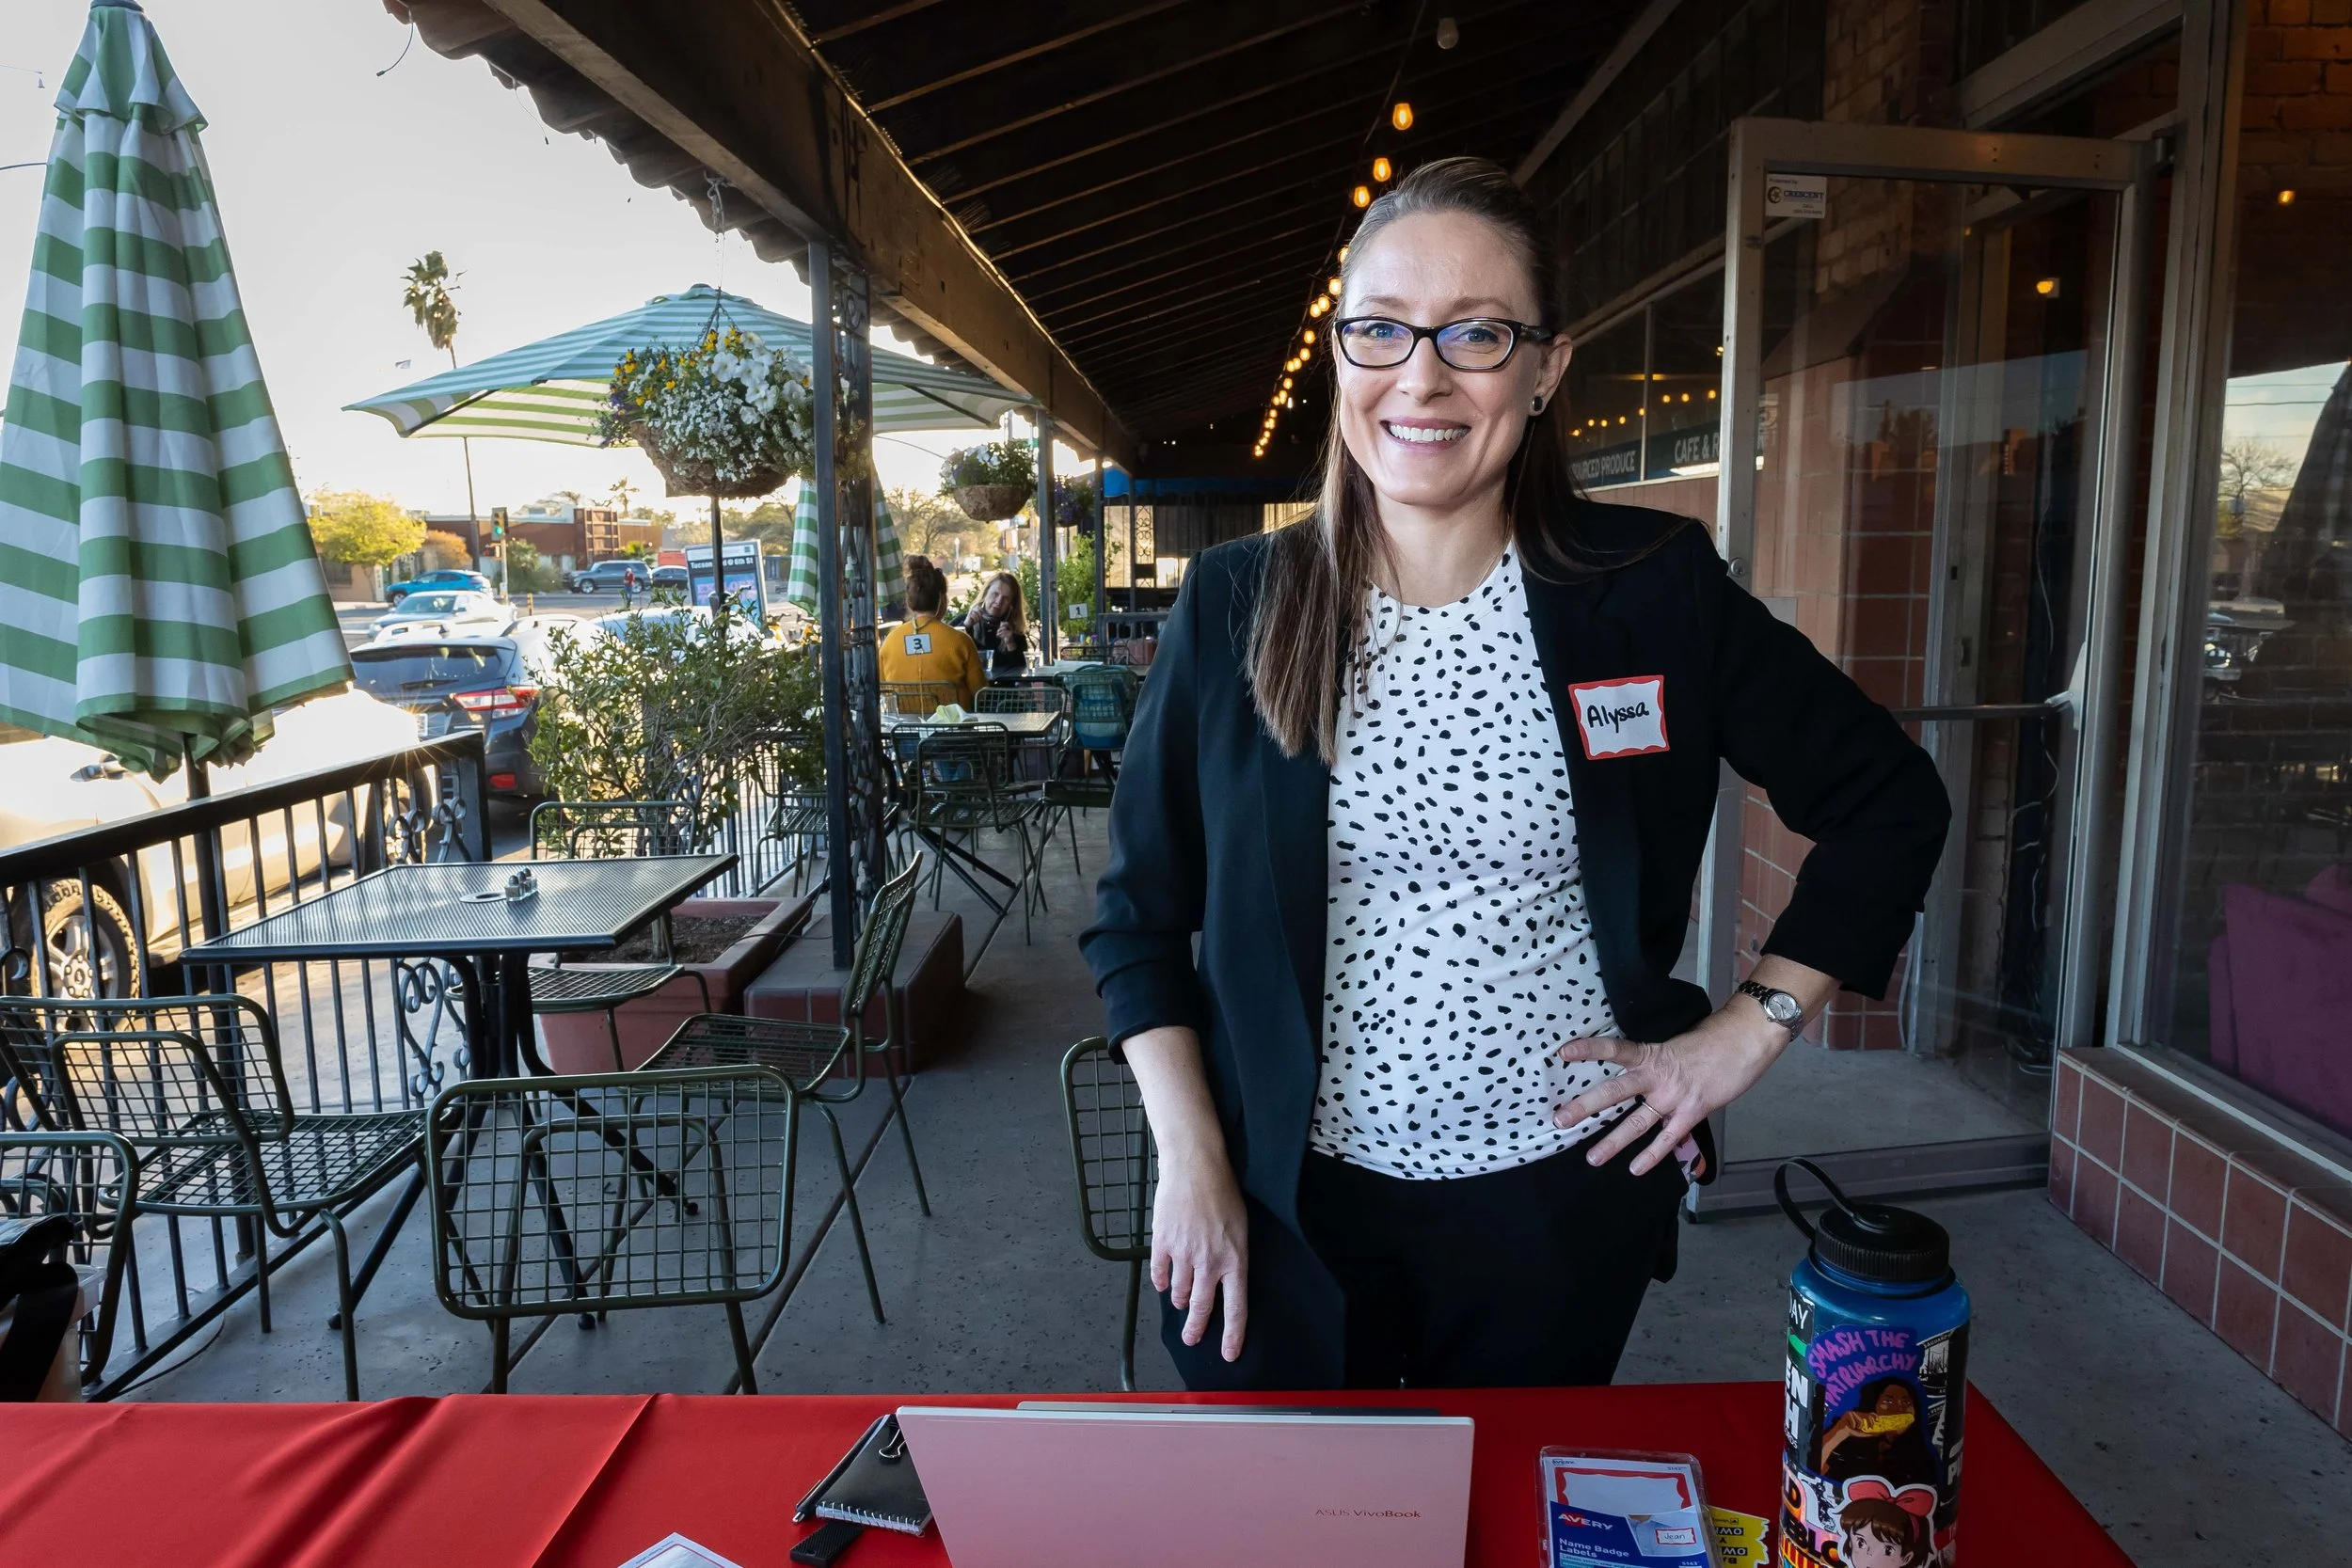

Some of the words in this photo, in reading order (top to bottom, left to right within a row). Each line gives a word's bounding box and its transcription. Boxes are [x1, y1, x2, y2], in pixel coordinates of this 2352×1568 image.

[1784, 191, 1823, 199] CRESCENT
[1675, 436, 1700, 464] CAFE
[1702, 435, 1709, 460] &
[1601, 451, 1636, 476] PRODUCE
[913, 638, 923, 650] 3
[1587, 702, 1649, 734] Alyssa
[1808, 1330, 1866, 1379] SMASH
[1865, 1329, 1910, 1349] THE
[1558, 1513, 1613, 1530] AVERY
[1559, 1544, 1597, 1558] Labels
[1560, 1538, 1592, 1550] Name
[1594, 1544, 1629, 1558] Badge
